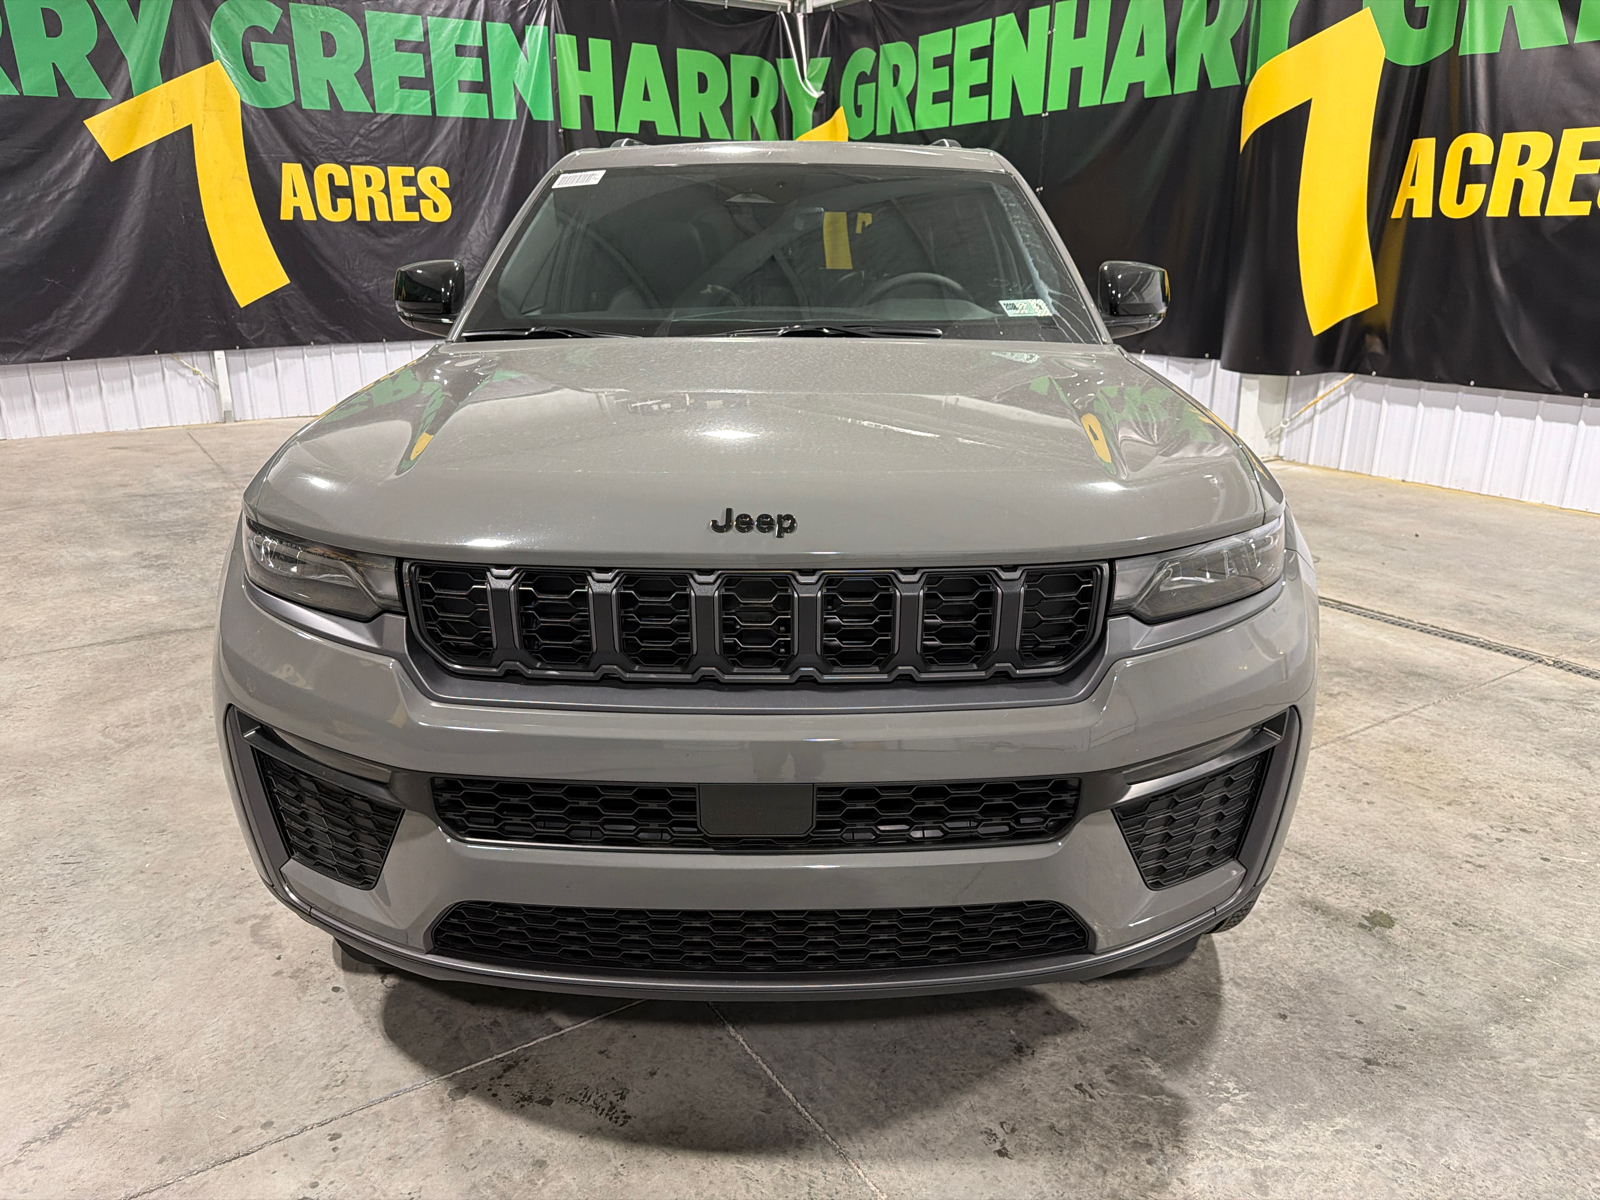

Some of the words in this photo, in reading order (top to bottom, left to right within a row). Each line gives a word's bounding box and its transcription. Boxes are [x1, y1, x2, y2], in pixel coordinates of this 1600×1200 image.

[0, 0, 173, 99] RY
[210, 0, 554, 121] GREEN
[555, 33, 831, 141] HARRY
[840, 6, 1050, 140] GREEN
[83, 60, 290, 308] 7
[280, 163, 452, 222] ACRES
[1240, 7, 1386, 336] 7
[1390, 126, 1600, 219] ACRE
[710, 507, 797, 538] Jeep
